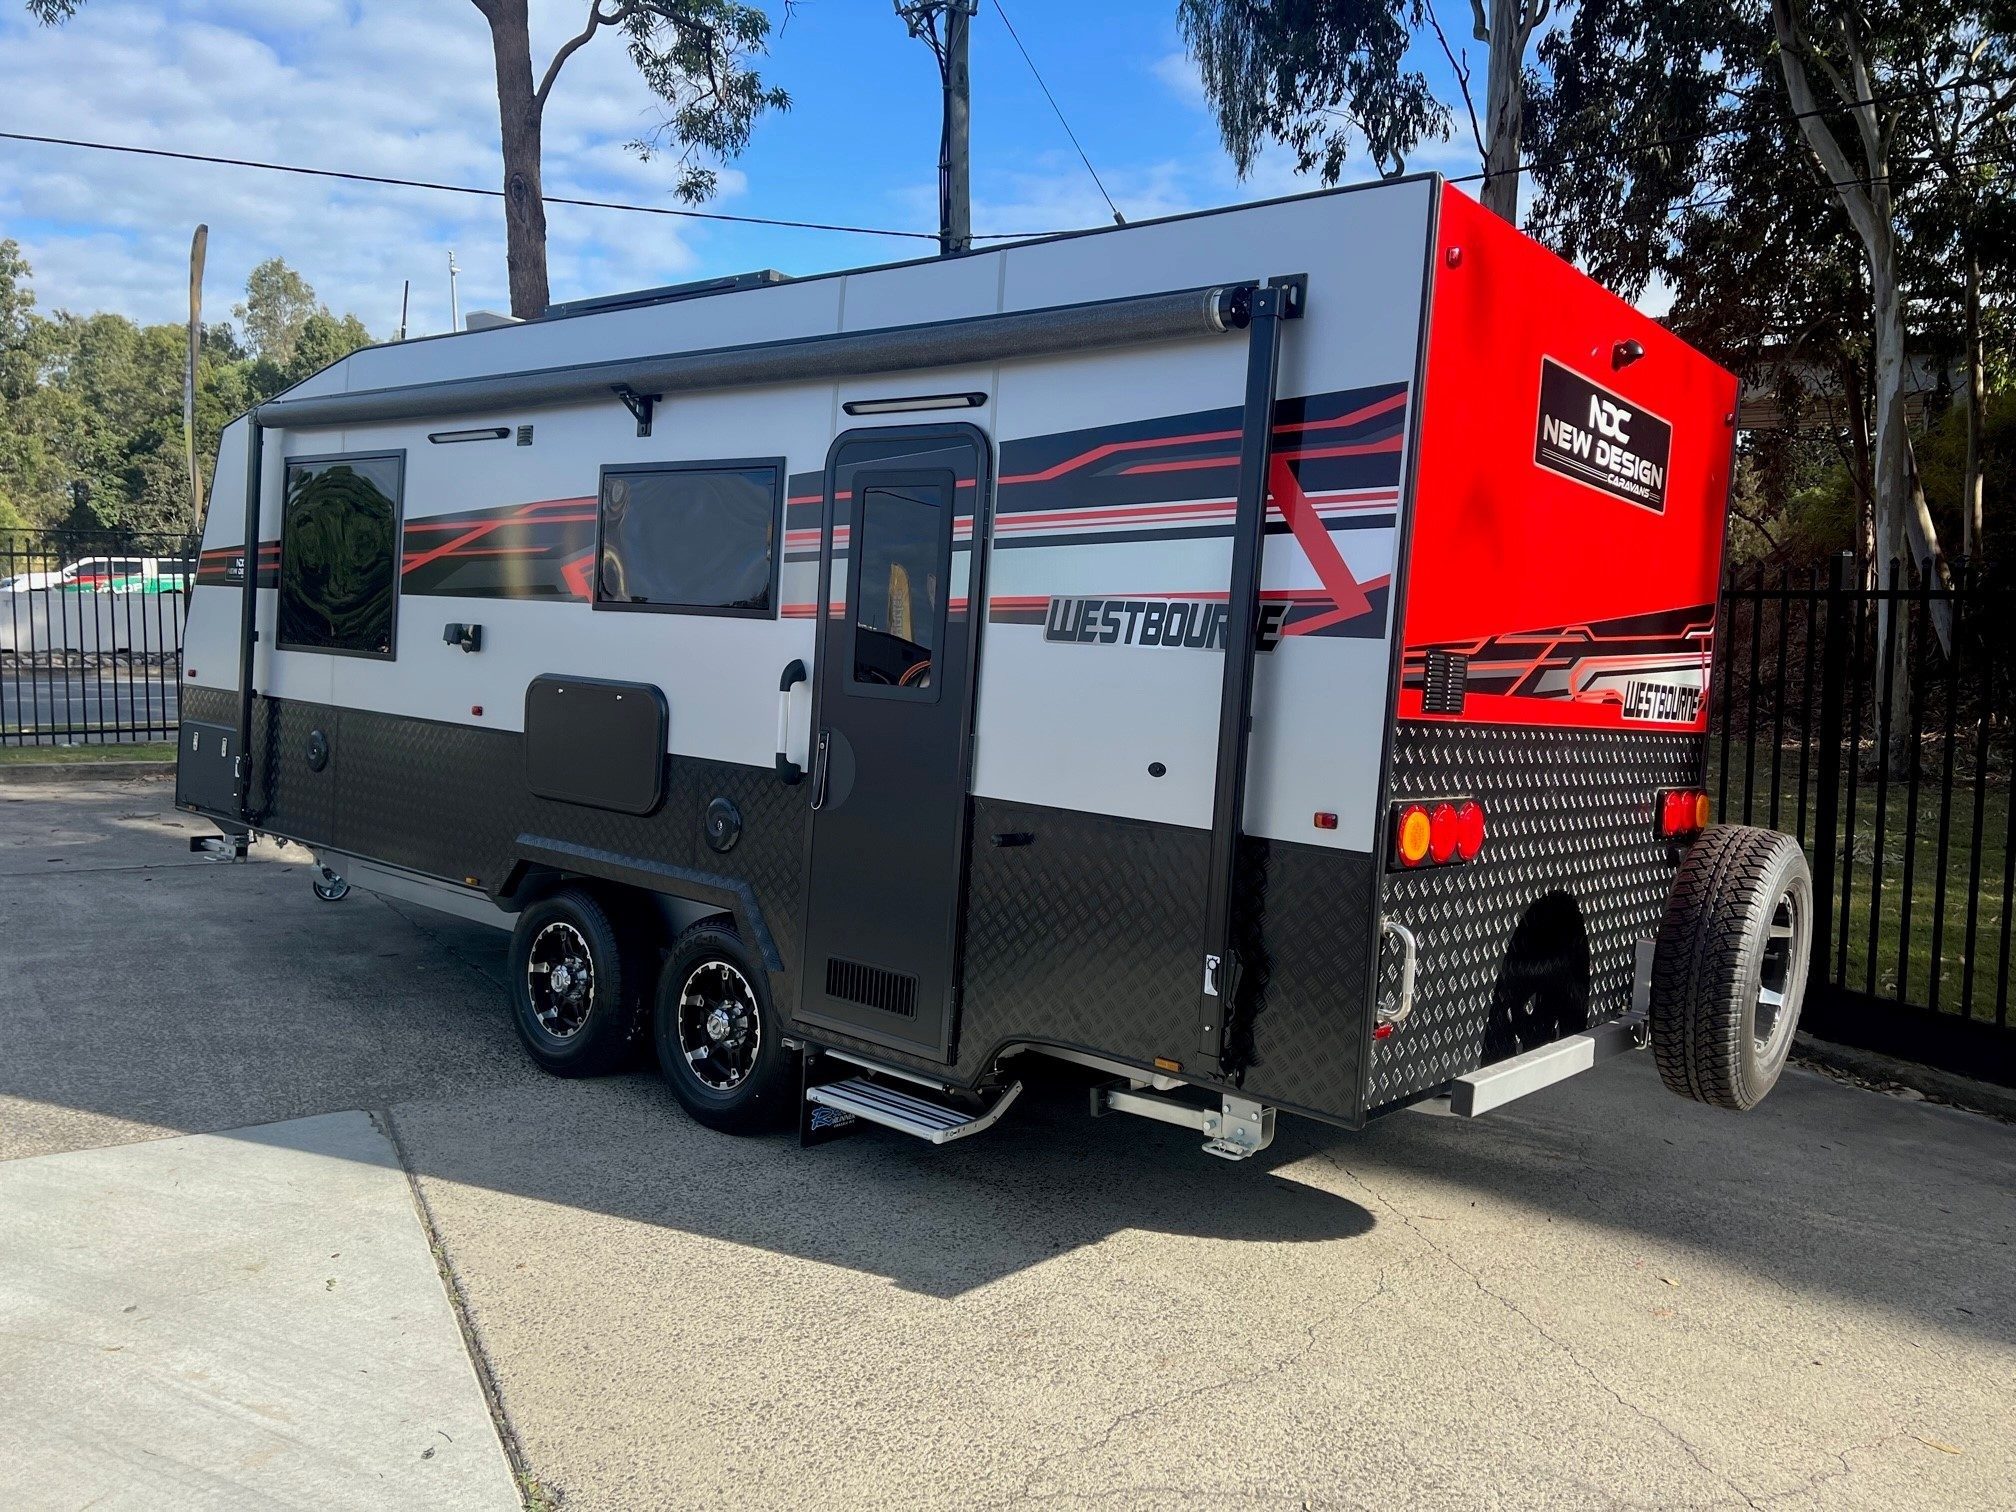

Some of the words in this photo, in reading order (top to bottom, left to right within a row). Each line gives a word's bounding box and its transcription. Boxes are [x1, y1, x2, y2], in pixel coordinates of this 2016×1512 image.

[1589, 394, 1632, 444] NDC
[1543, 414, 1593, 459] NEW
[1595, 440, 1663, 490] DESIGN
[1606, 473, 1650, 499] CARAVANS
[1046, 599, 1287, 652] WESTBOURE
[1623, 680, 1700, 722] WESTBOURNE
